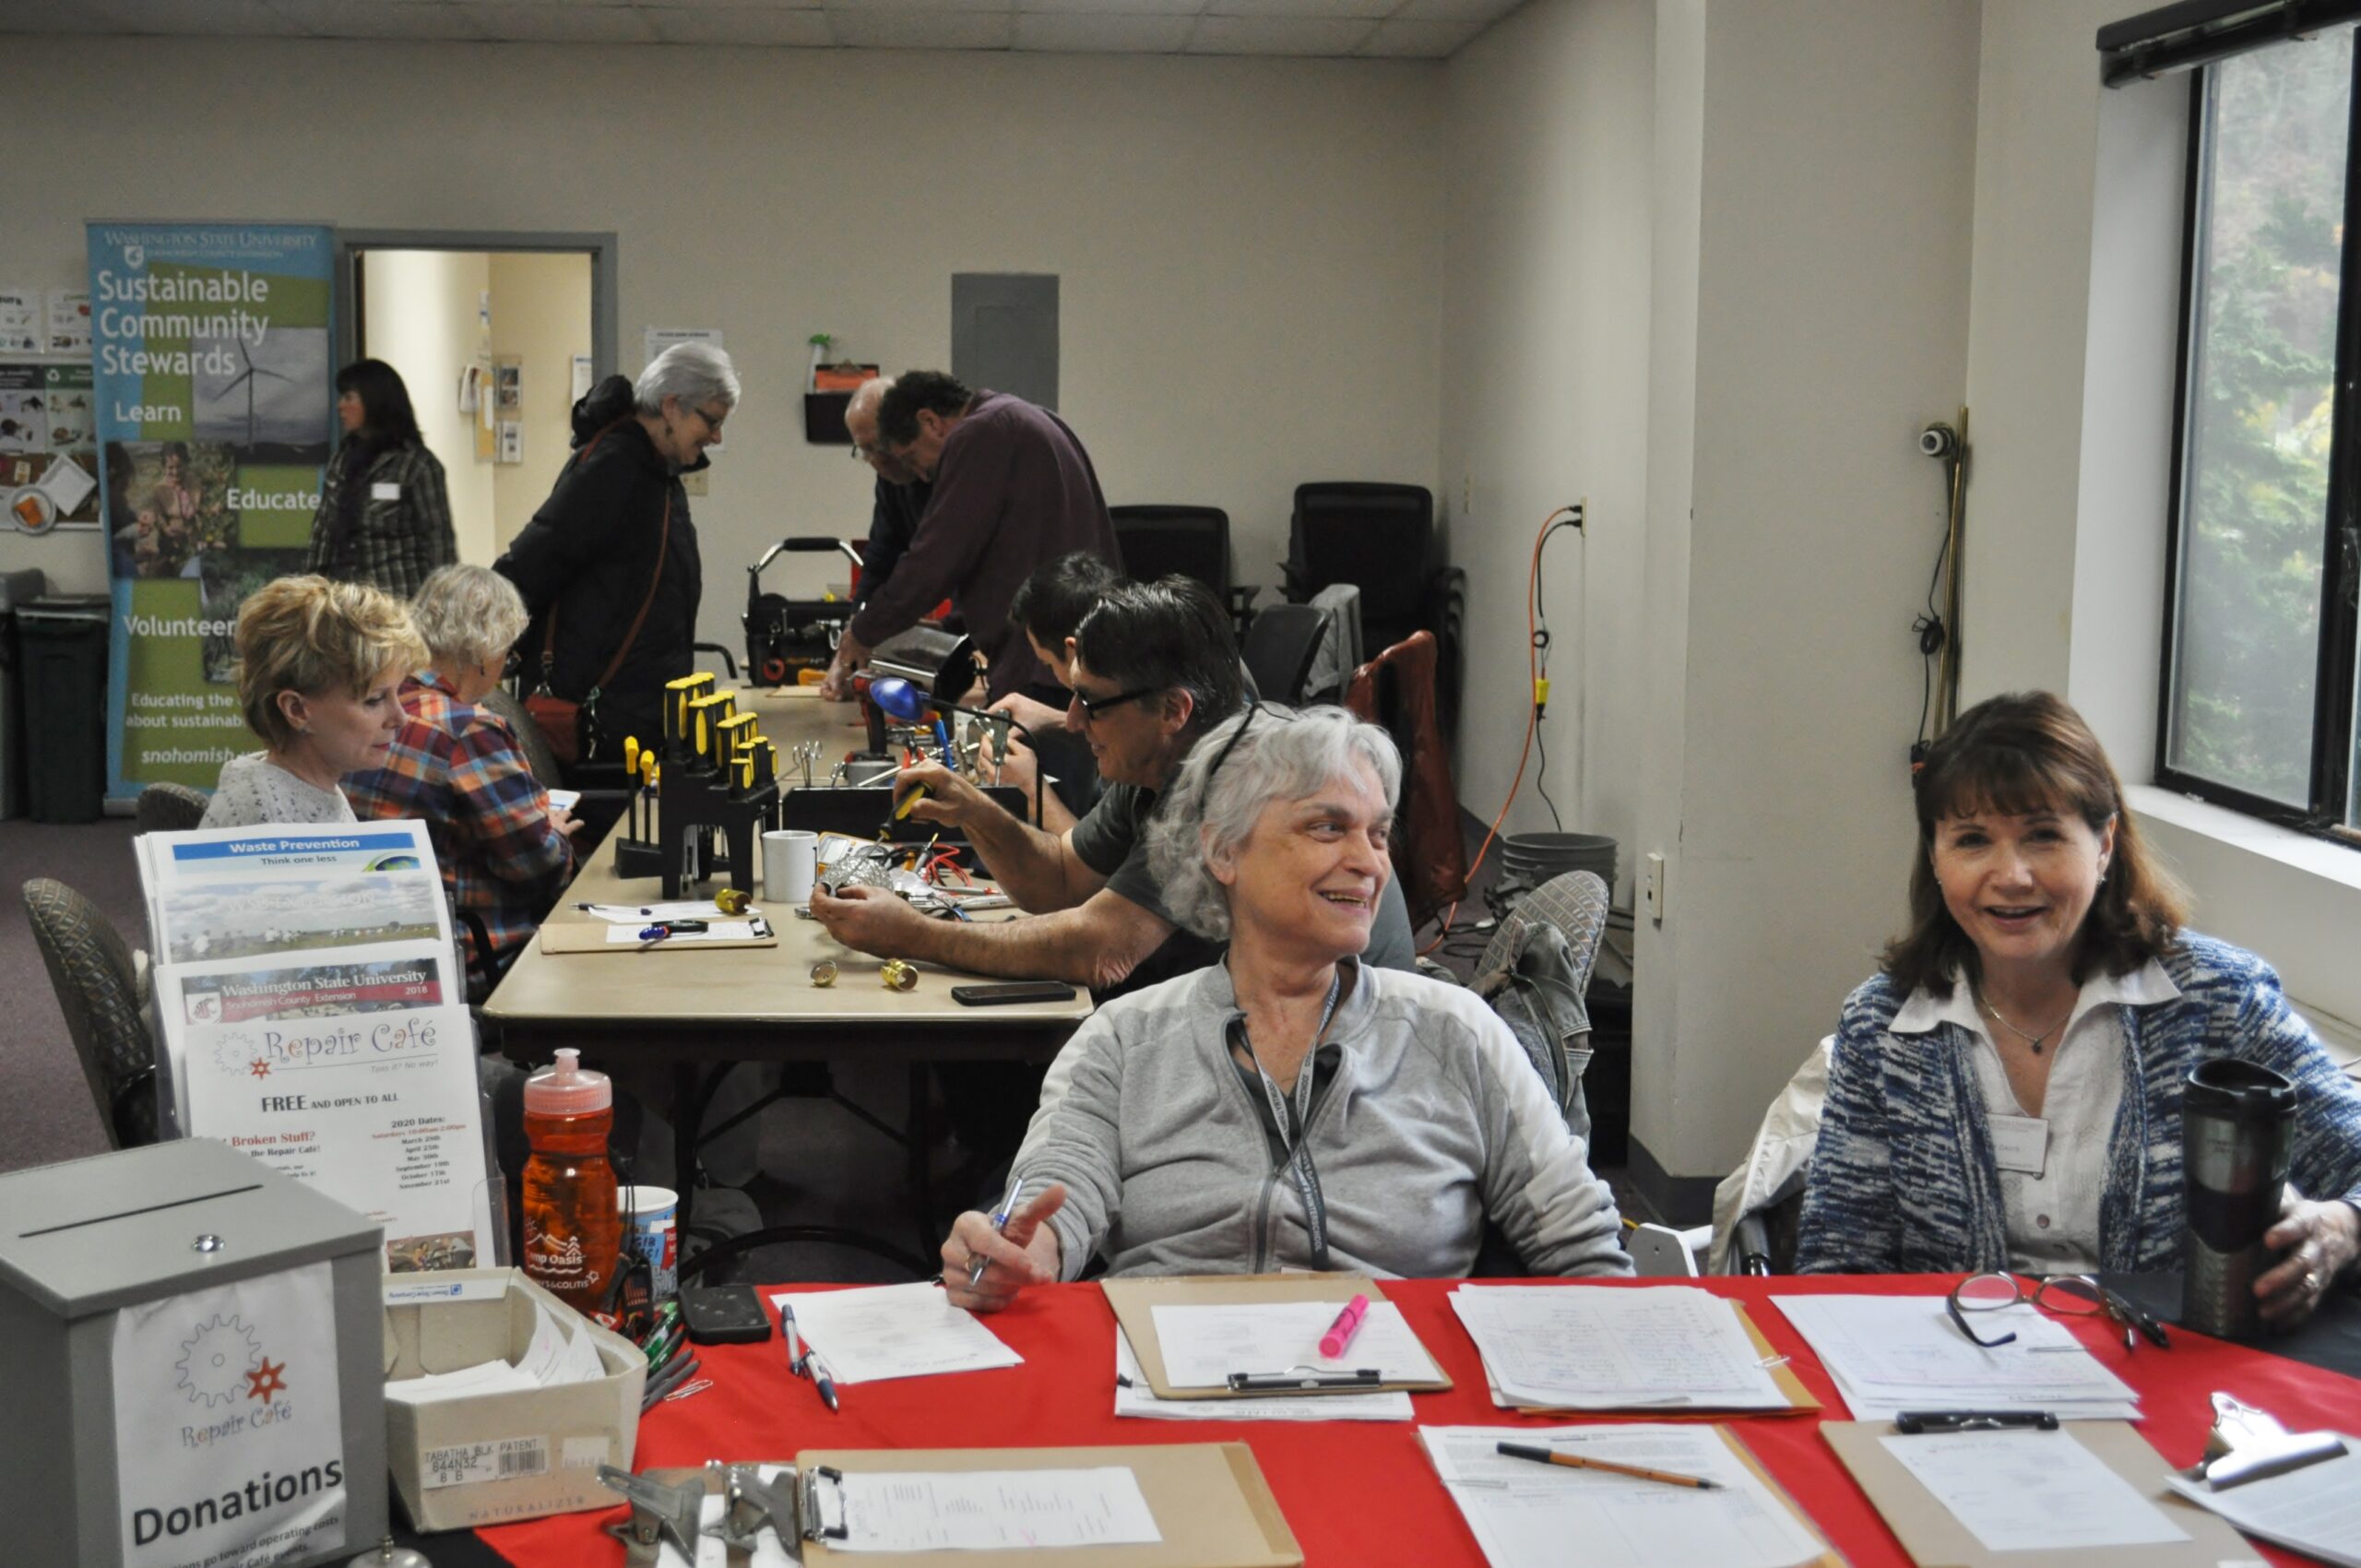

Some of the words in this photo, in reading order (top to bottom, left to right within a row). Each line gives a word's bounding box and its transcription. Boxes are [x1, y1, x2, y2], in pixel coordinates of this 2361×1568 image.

[98, 269, 269, 303] Sustainable
[100, 308, 269, 347] Community
[101, 344, 236, 376] Stewards
[115, 401, 182, 422] Learn
[227, 489, 321, 510] Educate
[124, 615, 237, 636] Volunteer
[132, 693, 205, 710] Educating
[209, 694, 233, 707] the
[125, 714, 167, 729] about
[172, 715, 246, 728] sustainab
[230, 841, 277, 854] Waste
[280, 837, 360, 851] Prevention
[261, 857, 291, 866] Think
[297, 855, 314, 863] one
[317, 854, 337, 862] less
[222, 982, 312, 997] Washington
[315, 977, 350, 990] State
[354, 971, 427, 987] University
[405, 985, 428, 995] 2018
[279, 995, 311, 1005] County
[315, 992, 356, 1003] Extension
[265, 1028, 362, 1065] Repair
[372, 1017, 437, 1052] Café
[261, 1095, 309, 1112] FREE
[311, 1100, 331, 1110] AND
[335, 1097, 362, 1107] OPEN
[365, 1095, 378, 1105] TO
[381, 1093, 399, 1102] ALL
[391, 1119, 415, 1128] 2020
[418, 1116, 445, 1125] Dates:
[231, 1134, 277, 1146] Broken
[280, 1131, 315, 1143] Stuff?
[401, 1136, 422, 1145] March
[251, 1148, 266, 1158] the
[267, 1146, 296, 1157] Repair
[396, 1164, 432, 1173] September
[401, 1172, 428, 1182] October
[399, 1182, 433, 1190] November
[549, 1253, 583, 1265] Oasis
[557, 1279, 588, 1289] COLITIS
[182, 1417, 245, 1447] Repair
[251, 1401, 292, 1429] Café
[424, 1448, 469, 1462] TABATHA
[474, 1444, 494, 1457] BLK
[499, 1438, 538, 1452] PATENT
[433, 1456, 478, 1473] 844N32
[134, 1459, 343, 1547] Donations
[469, 1496, 586, 1519] NATURALIZER
[204, 1558, 217, 1567] go
[219, 1540, 256, 1561] toward
[259, 1525, 311, 1547] operating
[314, 1516, 338, 1531] costs
[247, 1555, 271, 1567] Café
[274, 1543, 308, 1560] events
